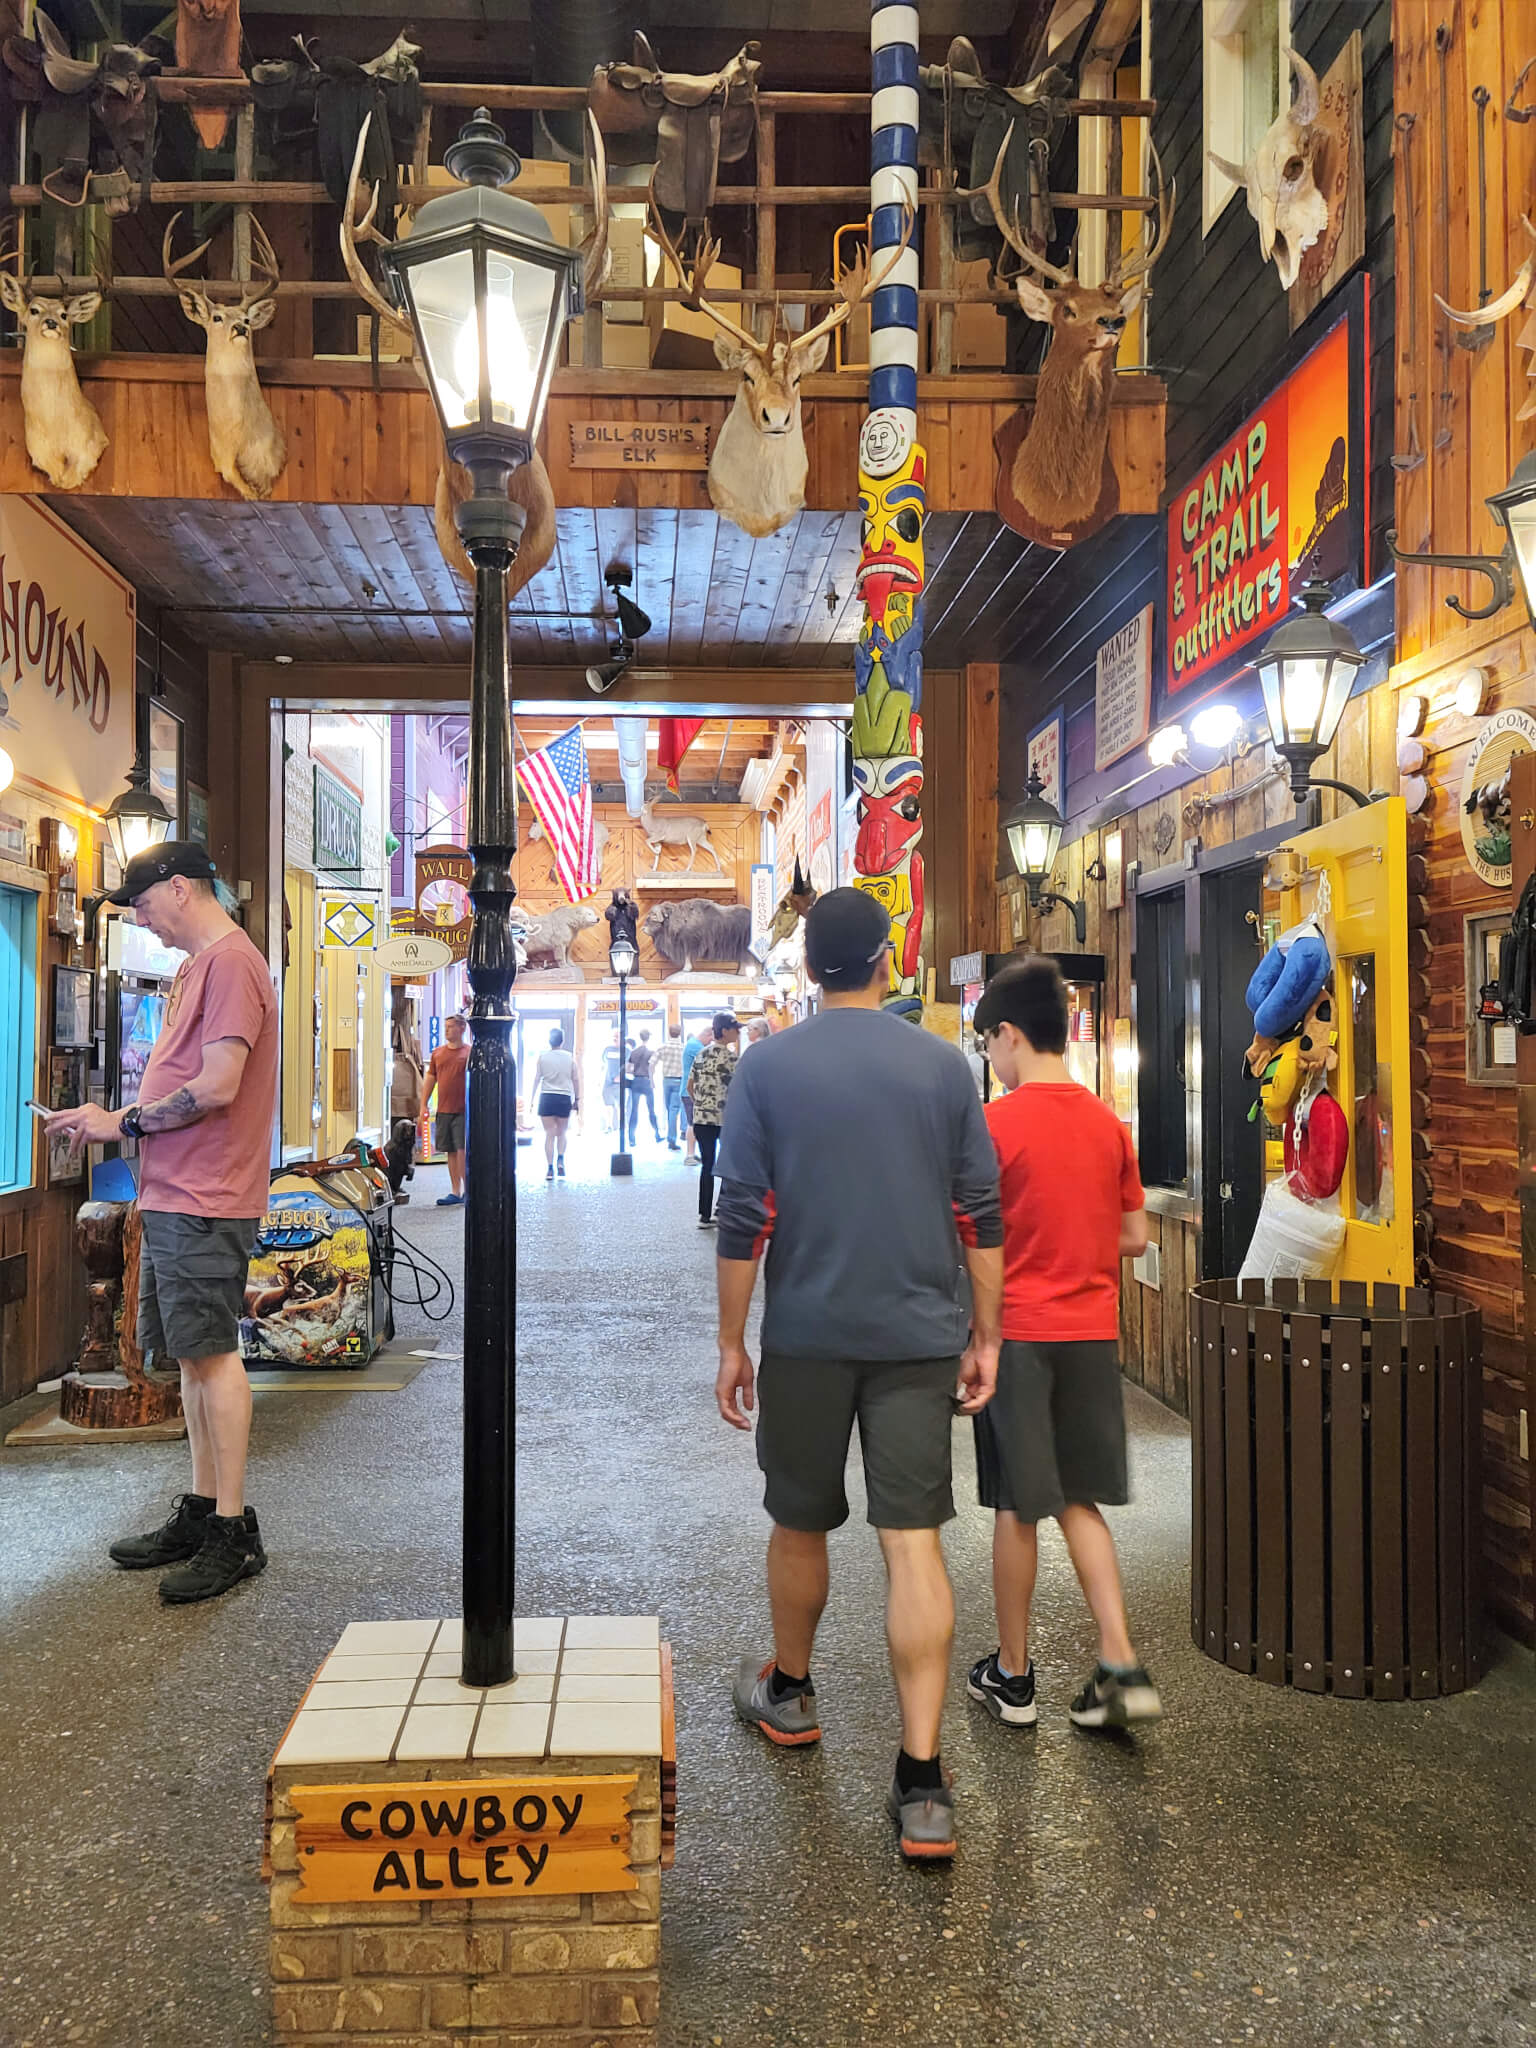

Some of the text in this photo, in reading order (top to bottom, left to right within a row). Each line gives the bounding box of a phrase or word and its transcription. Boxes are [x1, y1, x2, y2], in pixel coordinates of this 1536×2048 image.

[585, 427, 694, 443] BILL RUSH'S
[623, 448, 656, 463] ELK
[1182, 420, 1267, 543] CAMP
[1192, 480, 1280, 595] TRAIL
[1173, 557, 1282, 672] outfitters
[1101, 617, 1140, 669] WANTED
[1468, 714, 1536, 767] WELCOME
[321, 792, 357, 867] DRUGS
[421, 861, 469, 881] WALL
[1475, 857, 1491, 878] THE
[423, 928, 467, 945] DRUG
[952, 953, 981, 983] CAMPING
[600, 1001, 654, 1010] RESTOOMS
[261, 1210, 334, 1233] IG BUCK
[261, 1230, 316, 1246] HD
[341, 1793, 584, 1841] COWBOY
[373, 1843, 549, 1893] ALLEY
